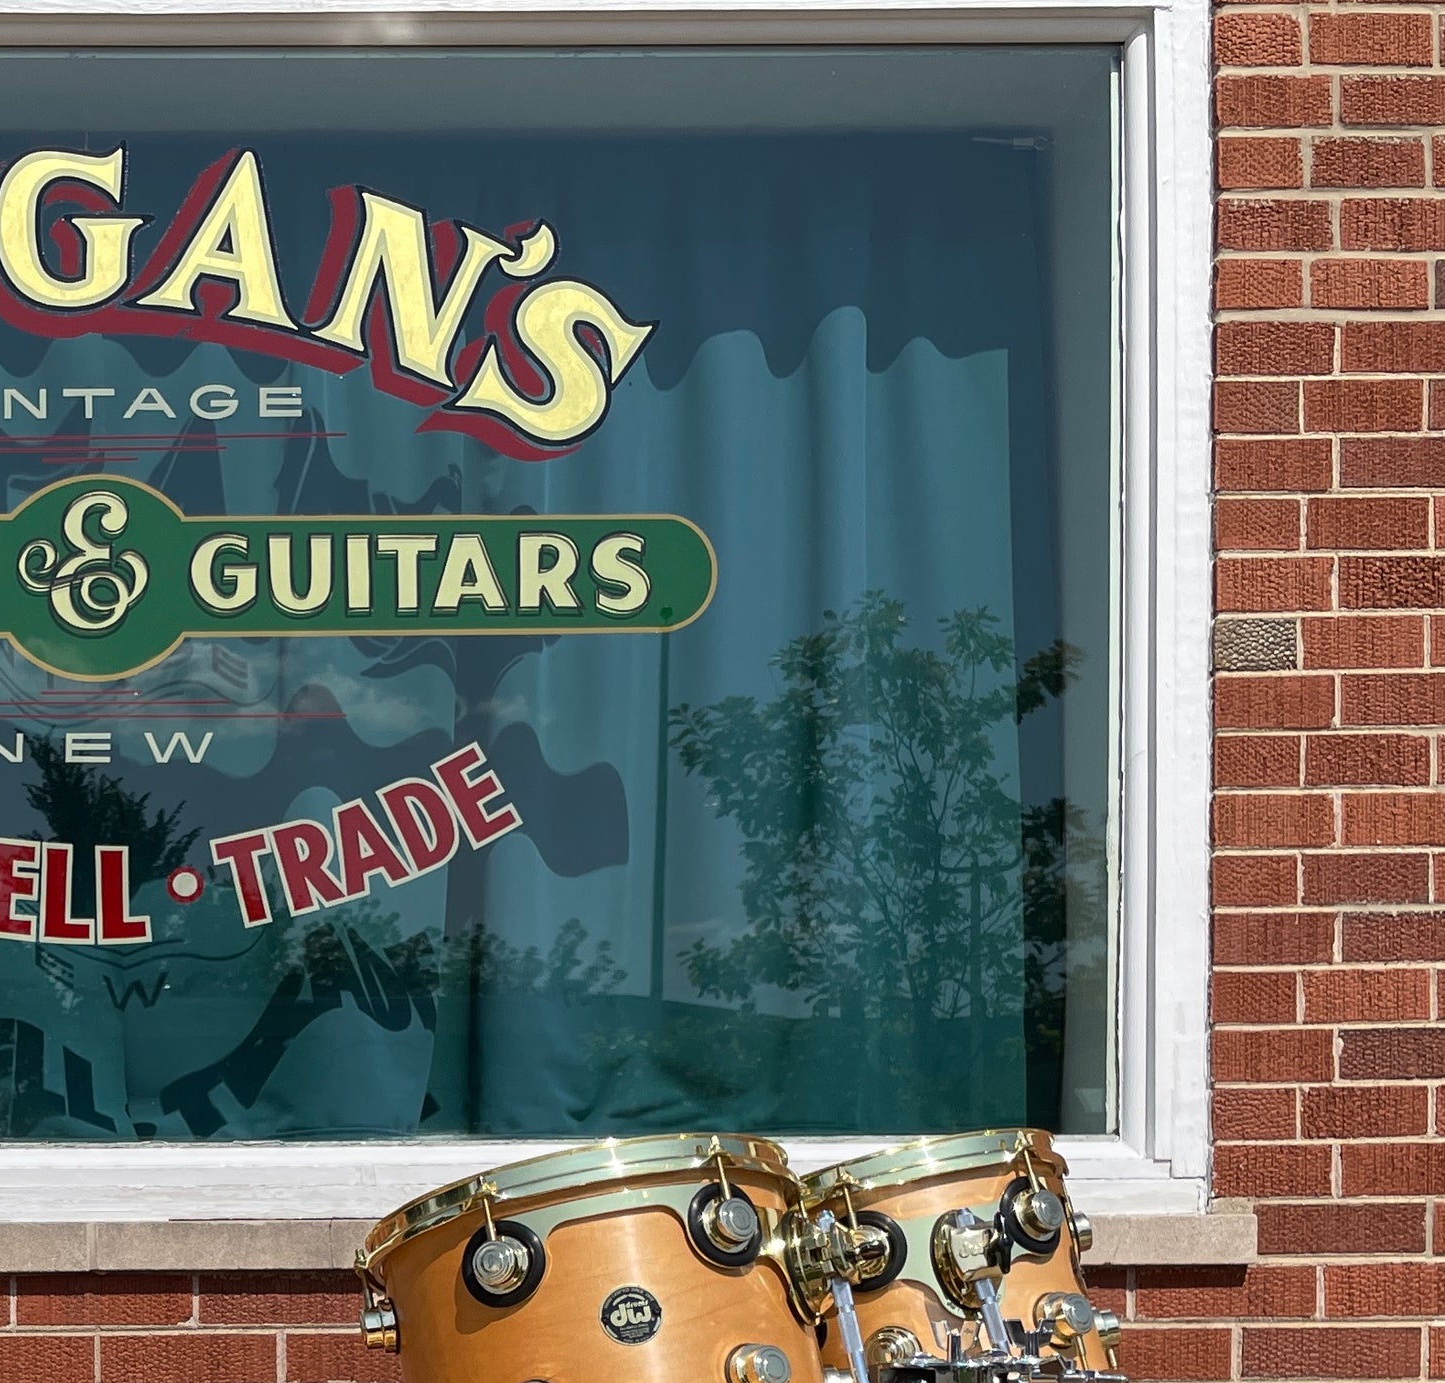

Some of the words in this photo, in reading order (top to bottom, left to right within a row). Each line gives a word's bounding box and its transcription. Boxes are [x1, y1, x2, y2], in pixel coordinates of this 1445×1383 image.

[18, 489, 149, 635] &
[188, 531, 653, 618] GUITARS
[209, 741, 524, 928] TRADE
[610, 1303, 652, 1327] dw
